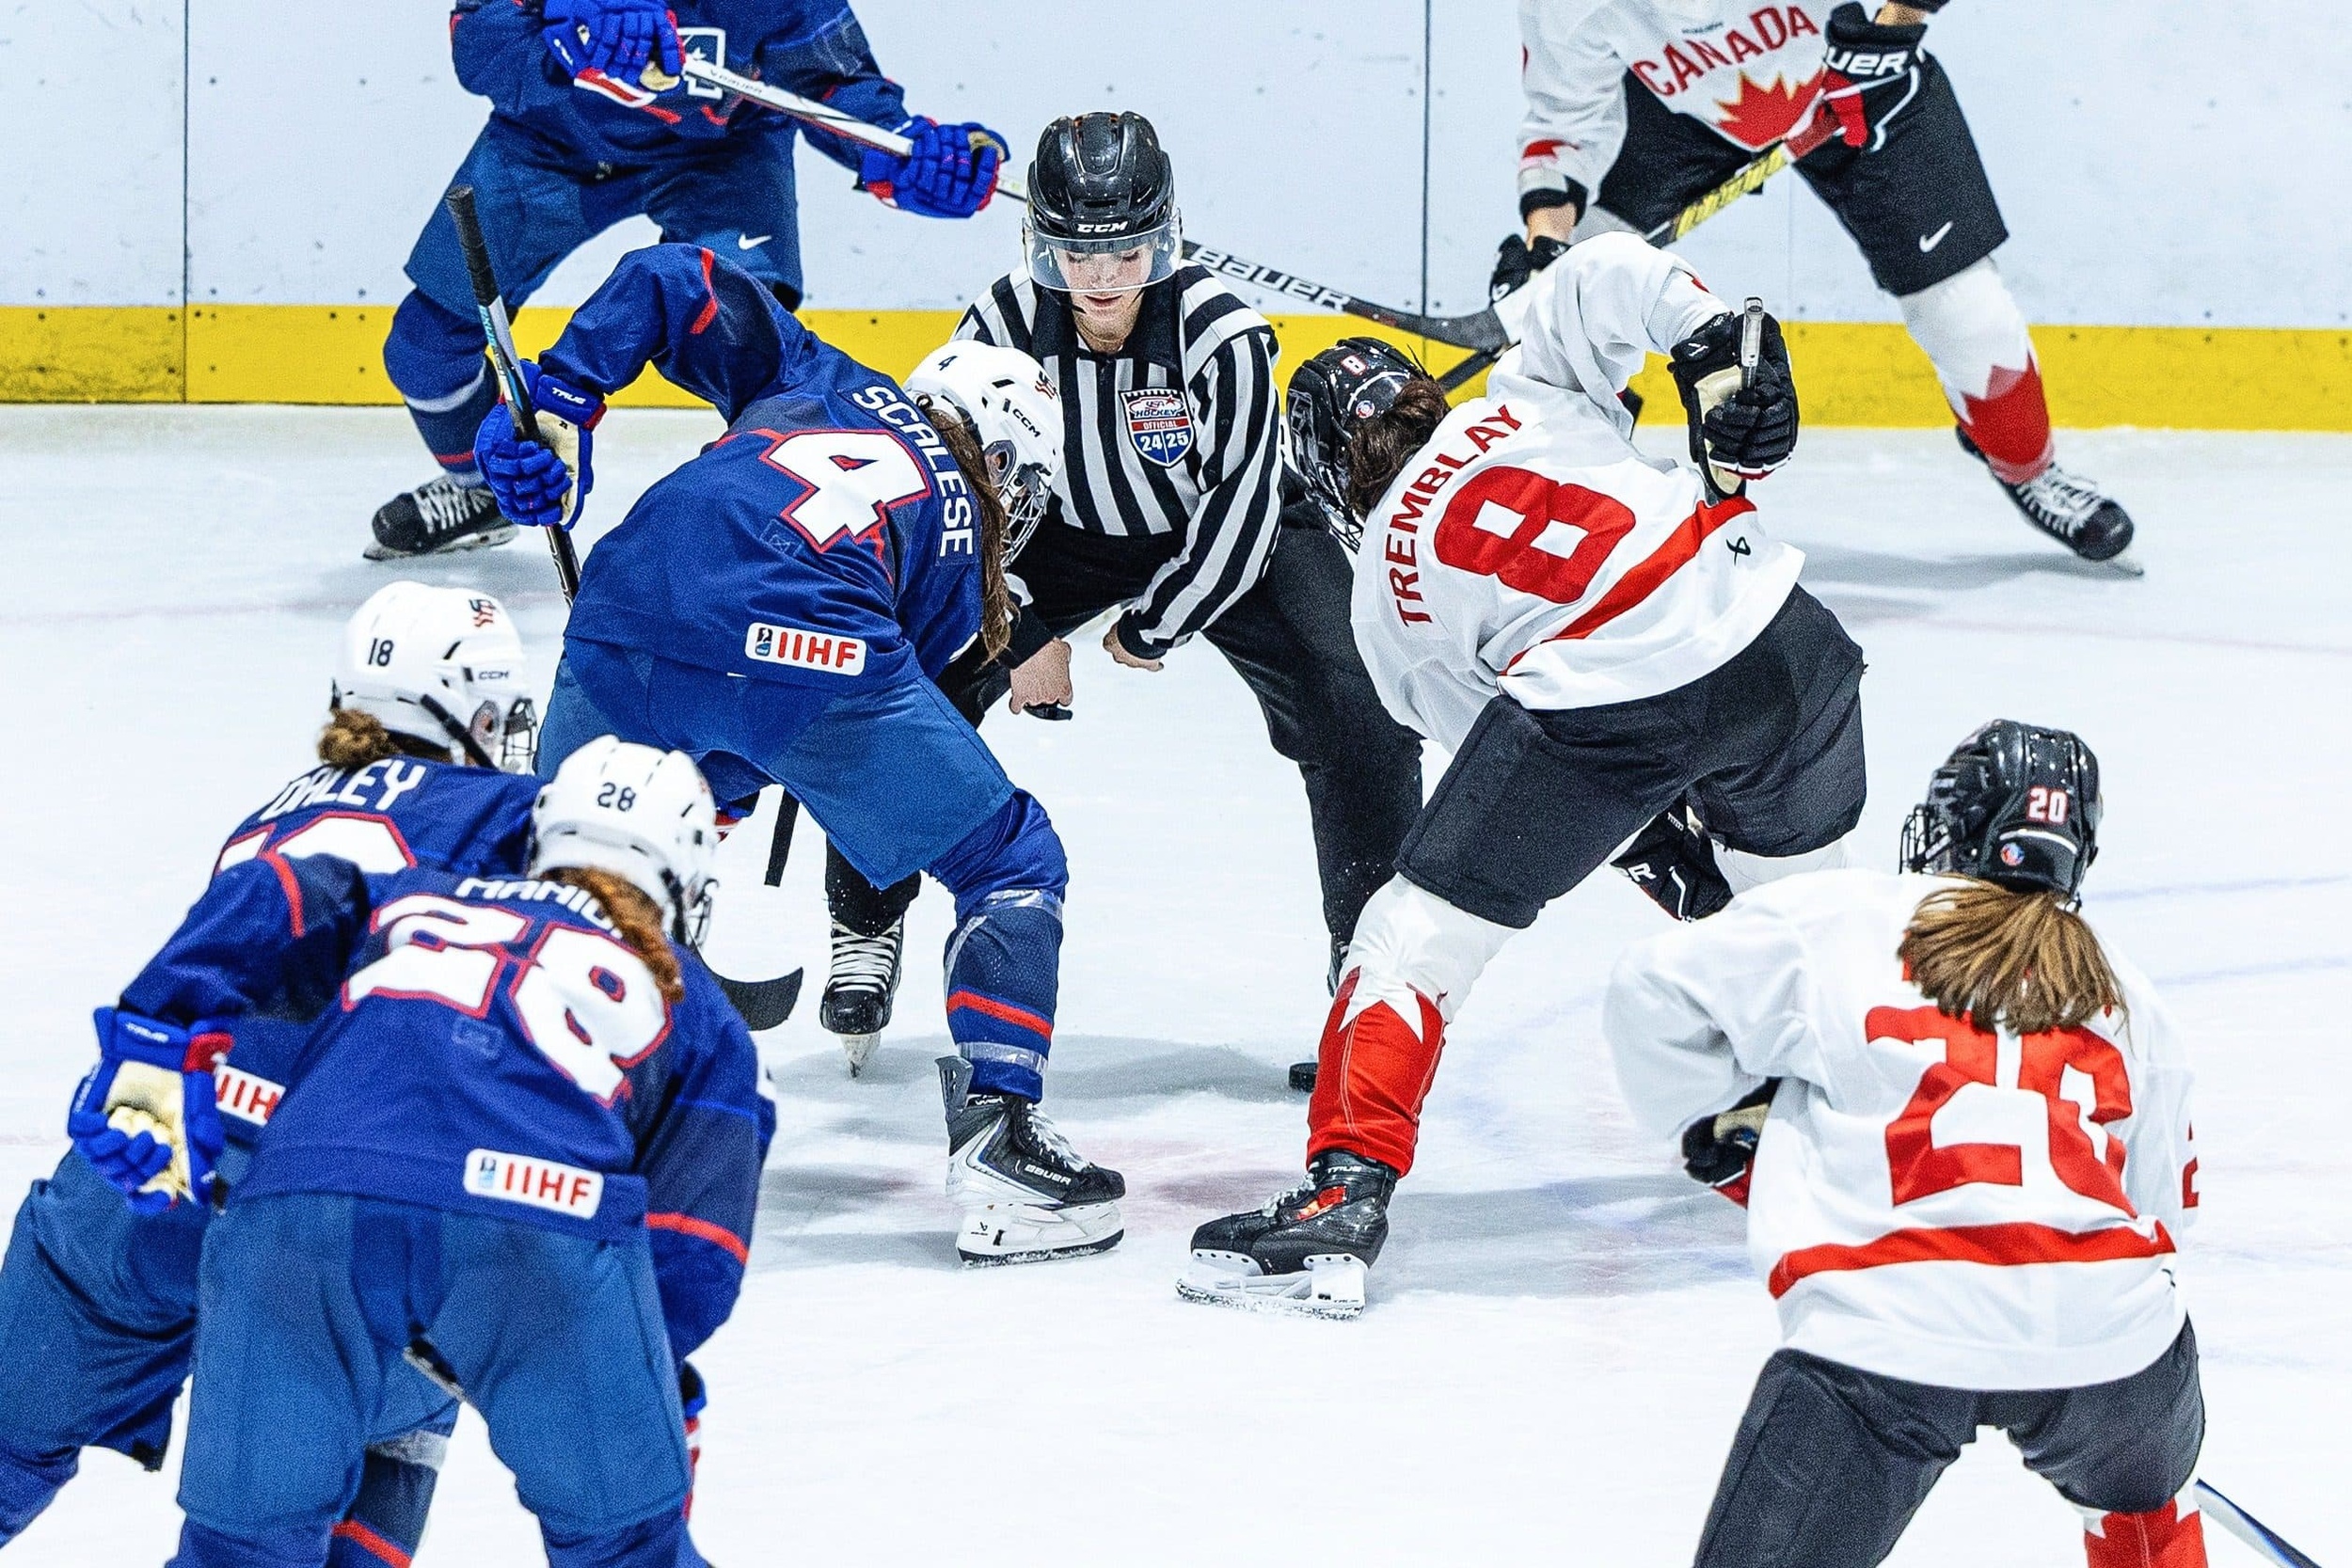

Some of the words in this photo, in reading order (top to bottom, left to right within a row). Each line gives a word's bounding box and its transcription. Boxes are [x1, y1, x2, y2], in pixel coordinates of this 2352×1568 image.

[1630, 7, 1820, 96] CANADA
[1826, 47, 1909, 75] UER
[1077, 221, 1128, 233] CCM
[1190, 244, 1351, 311] BAUER
[938, 356, 958, 371] 4
[1341, 354, 1367, 377] 8
[552, 387, 587, 404] TRUE
[1012, 408, 1041, 437] CCM
[1135, 409, 1177, 418] HOCKEY
[1142, 420, 1178, 430] OFFICIAL
[1140, 435, 1163, 451] 24
[1167, 431, 1189, 448] 25
[851, 386, 973, 557] SCALESE
[756, 428, 931, 555] 4
[1385, 404, 1524, 627] TREMBLAY
[1434, 465, 1637, 604] 8
[368, 638, 394, 667] 18
[777, 631, 858, 668] IIHF
[478, 671, 509, 680] CCM
[596, 782, 637, 812] 28
[2026, 786, 2069, 824] 20
[341, 892, 674, 1110] 28
[216, 1073, 282, 1121] IIH
[1024, 1164, 1073, 1186] BAUER
[1327, 1165, 1362, 1174] TRUE
[505, 1163, 592, 1206] IIHF
